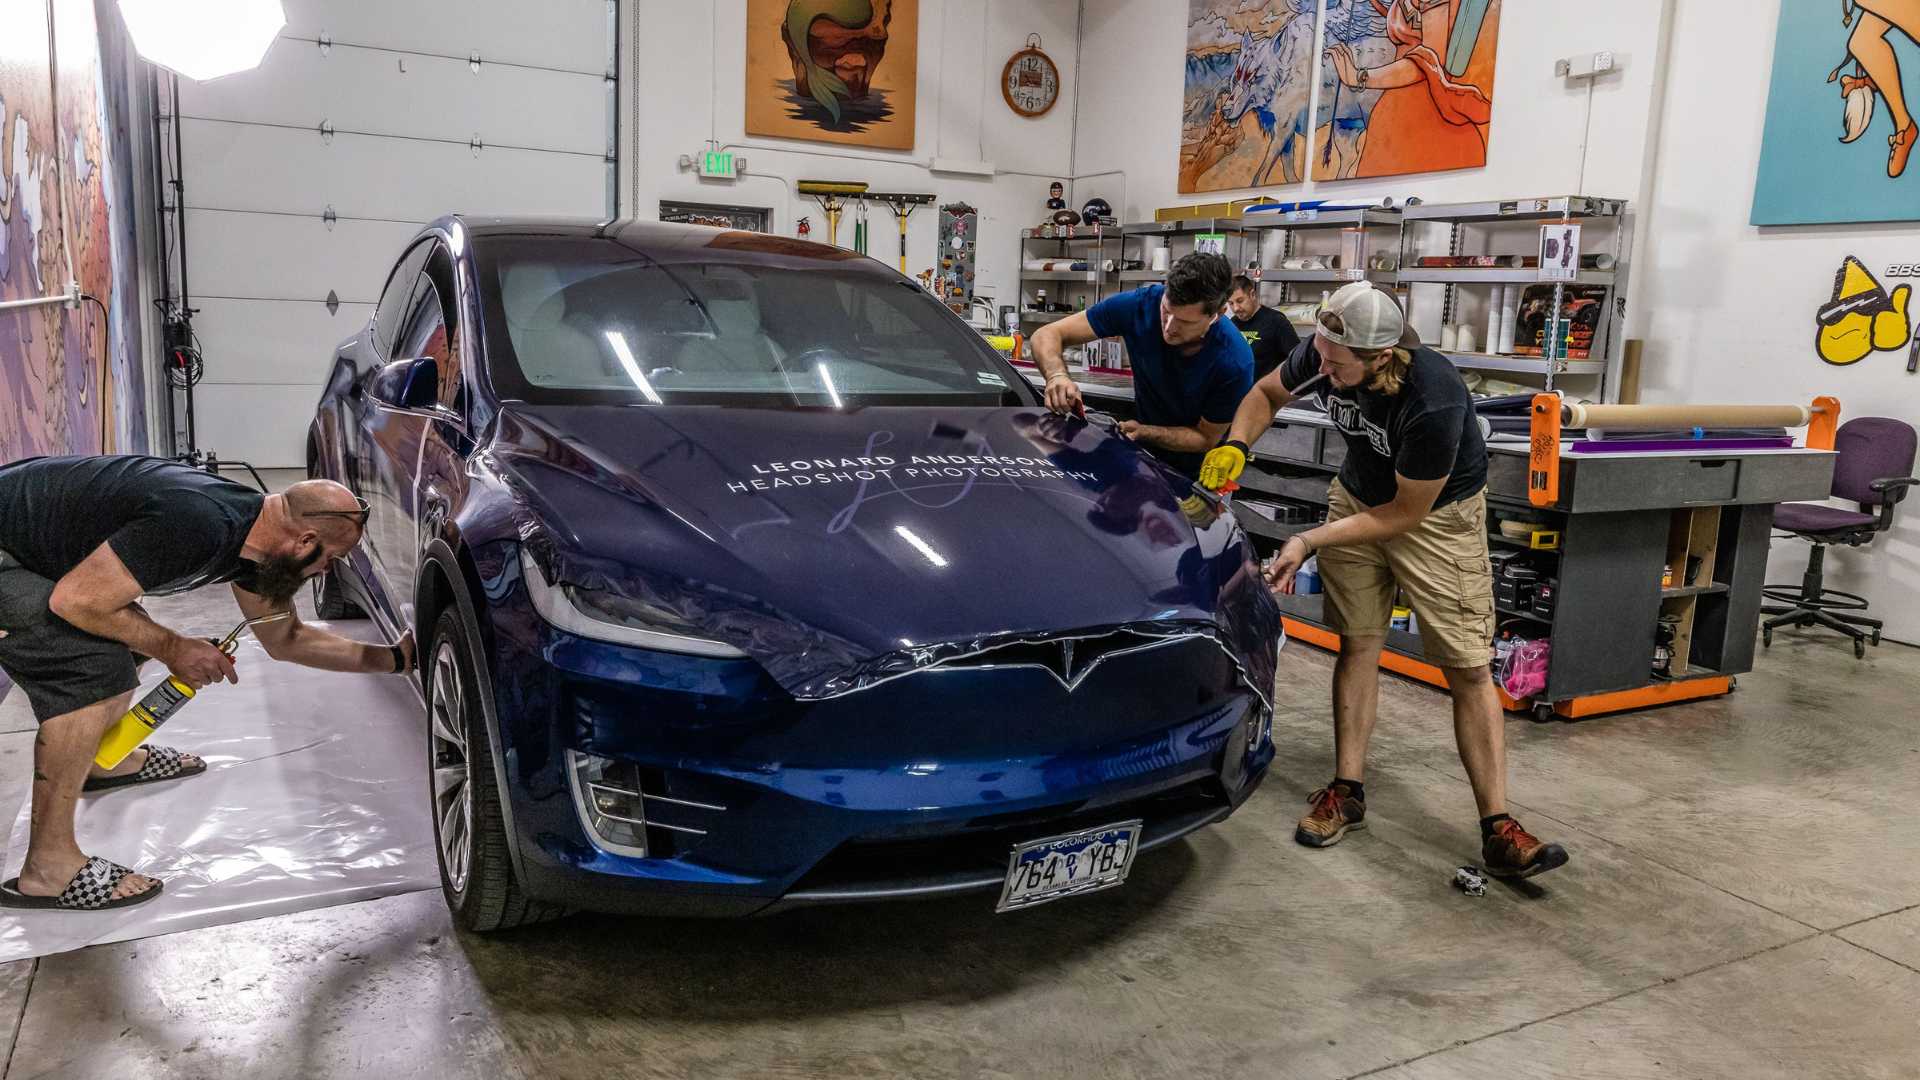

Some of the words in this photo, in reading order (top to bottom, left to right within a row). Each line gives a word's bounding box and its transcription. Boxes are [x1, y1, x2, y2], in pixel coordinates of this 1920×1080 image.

[1027, 57, 1039, 72] 12
[705, 152, 733, 176] EXIT
[752, 455, 896, 475] LEONARD
[911, 455, 1056, 468] ANDERSON
[727, 468, 894, 496] HEADSHOT
[905, 467, 1100, 483] PHOTOGRAPHY
[1013, 856, 1059, 892] 764
